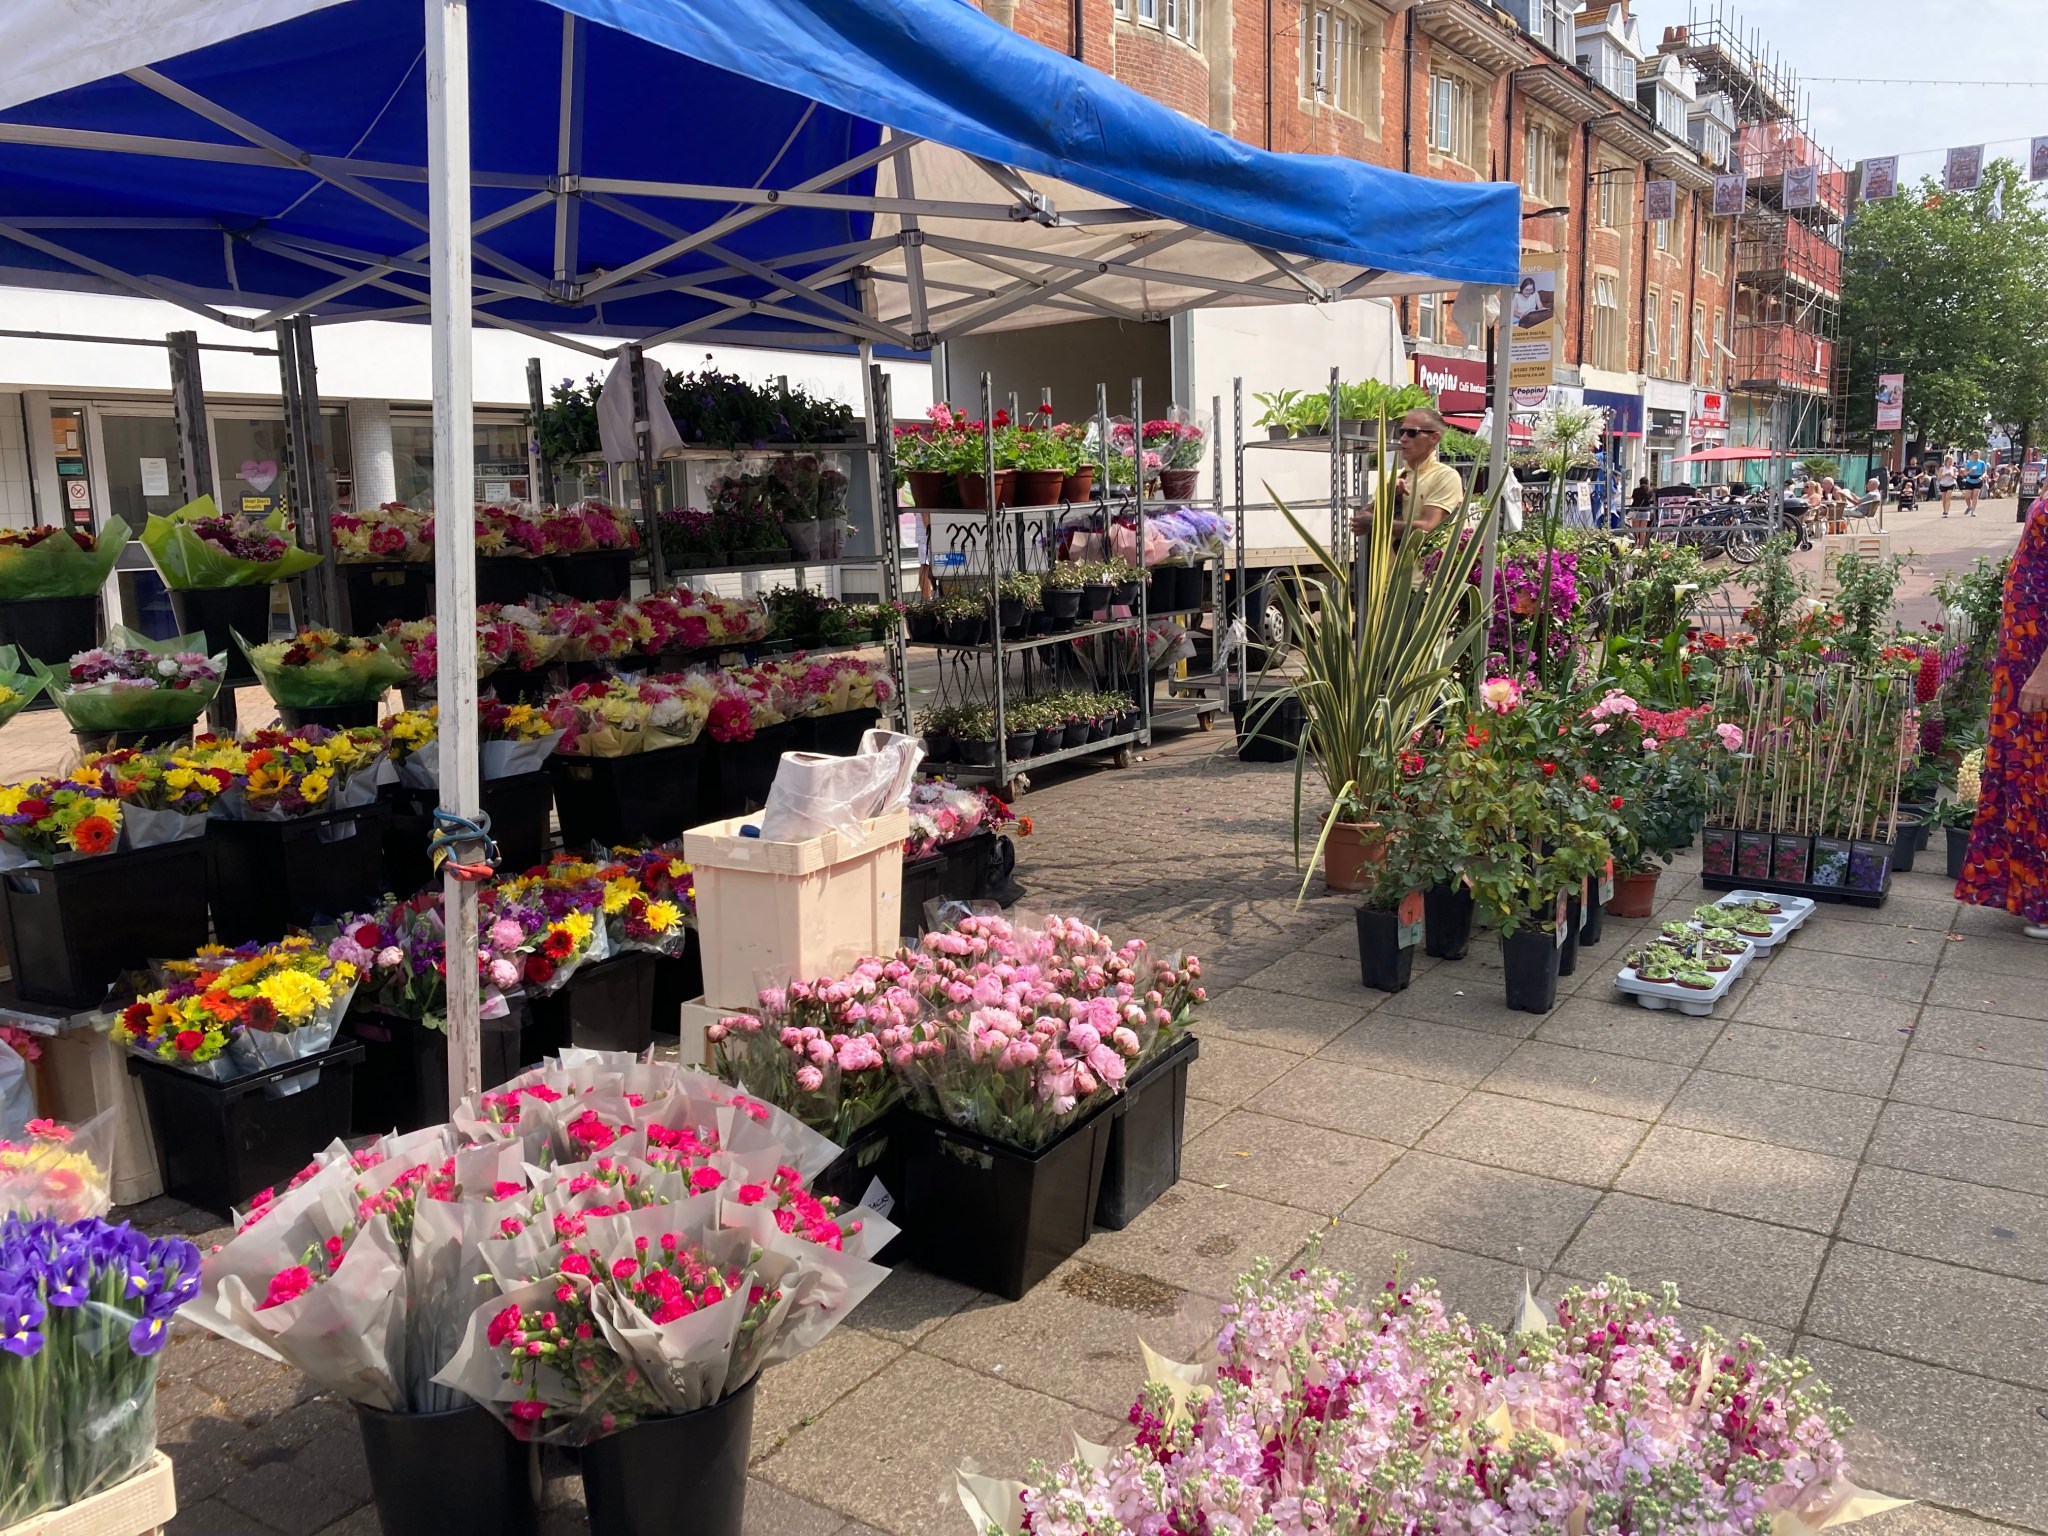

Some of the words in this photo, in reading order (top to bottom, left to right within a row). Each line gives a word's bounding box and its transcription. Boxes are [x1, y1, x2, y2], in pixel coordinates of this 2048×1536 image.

[1521, 265, 1542, 273] icuro
[1420, 364, 1458, 395] Poppins
[1459, 382, 1470, 392] Café
[1518, 387, 1544, 395] Poppins
